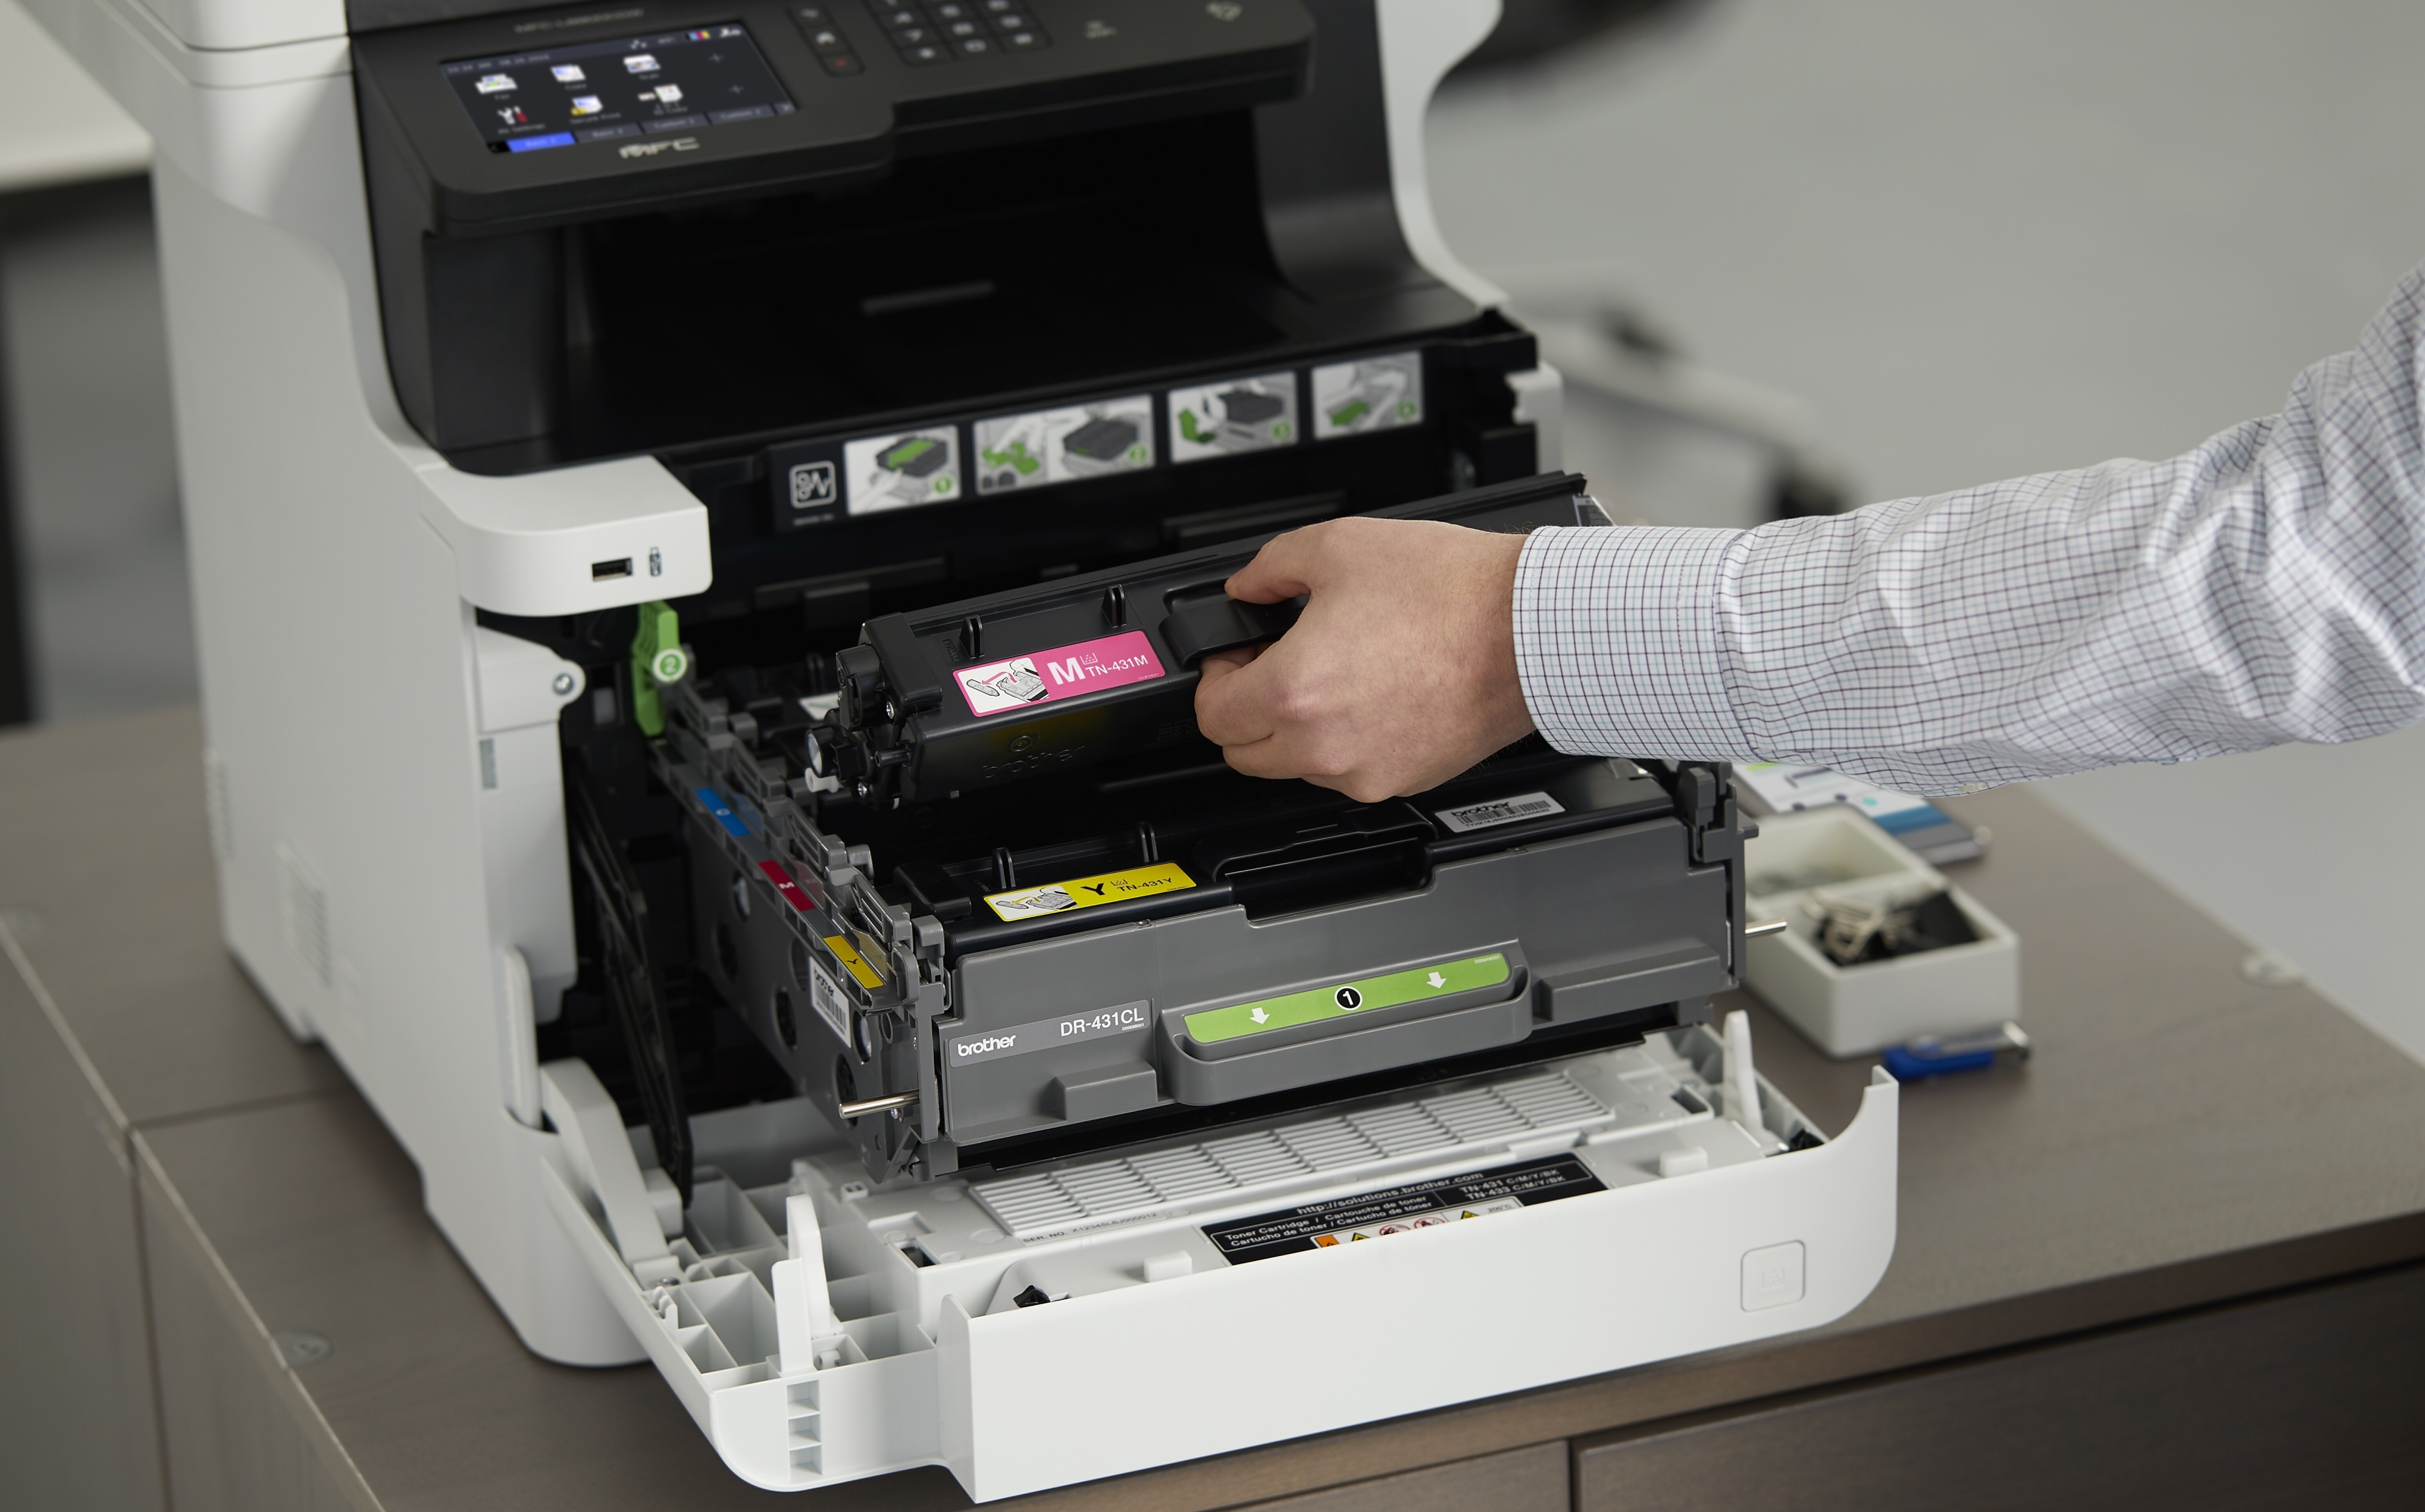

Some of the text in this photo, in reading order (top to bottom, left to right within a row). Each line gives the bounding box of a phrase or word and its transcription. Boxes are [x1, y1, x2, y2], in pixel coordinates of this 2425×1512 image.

[1047, 657, 1086, 685] M
[1085, 655, 1149, 677] TN-431M
[1451, 802, 1509, 816] brother
[1080, 883, 1105, 896] Y
[1117, 877, 1172, 892] TN-431Y
[1343, 991, 1354, 1005] 1
[958, 1008, 1144, 1057] brother DR-431CL
[1297, 1172, 1484, 1214] http://solutions.brother.com
[1459, 1180, 1503, 1194] TN-431
[1465, 1187, 1510, 1200] TN-433
[1225, 1231, 1256, 1241] Toner
[1258, 1220, 1310, 1233] Cartridge
[1324, 1206, 1381, 1221] Cartouche
[1398, 1196, 1427, 1205] toner
[1231, 1233, 1281, 1246] Cartucho
[1299, 1223, 1327, 1233] toner
[1337, 1211, 1386, 1225] Cartucho
